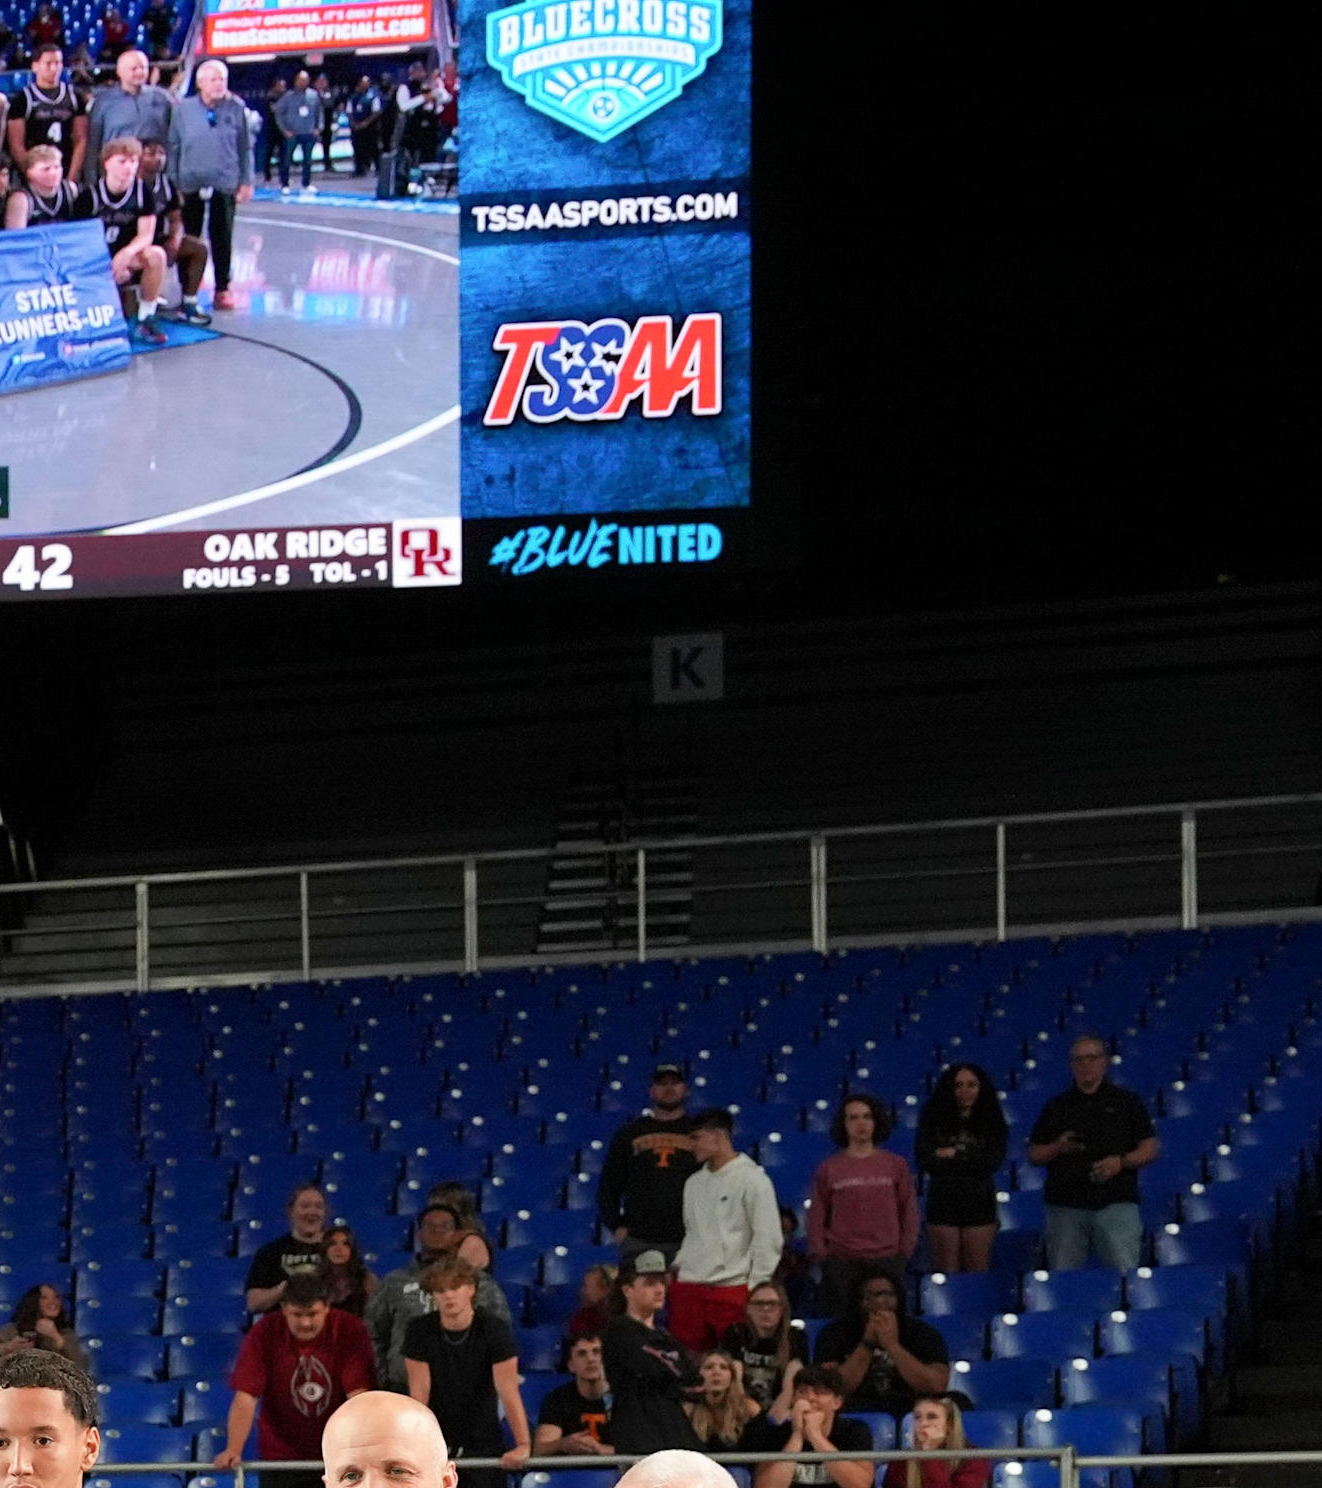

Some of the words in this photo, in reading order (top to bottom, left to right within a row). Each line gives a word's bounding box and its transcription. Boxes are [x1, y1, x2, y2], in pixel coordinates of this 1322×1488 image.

[498, 0, 711, 57] BLUECROSS
[472, 192, 737, 232] TSSAASPORTS.COM
[16, 284, 78, 317] STATE
[204, 533, 278, 561] OAK
[287, 528, 386, 558] RIDGE
[3, 544, 72, 590] 42
[184, 566, 256, 588] FOULS
[310, 562, 356, 582] TOL
[375, 560, 387, 580] 1
[670, 646, 705, 690] K
